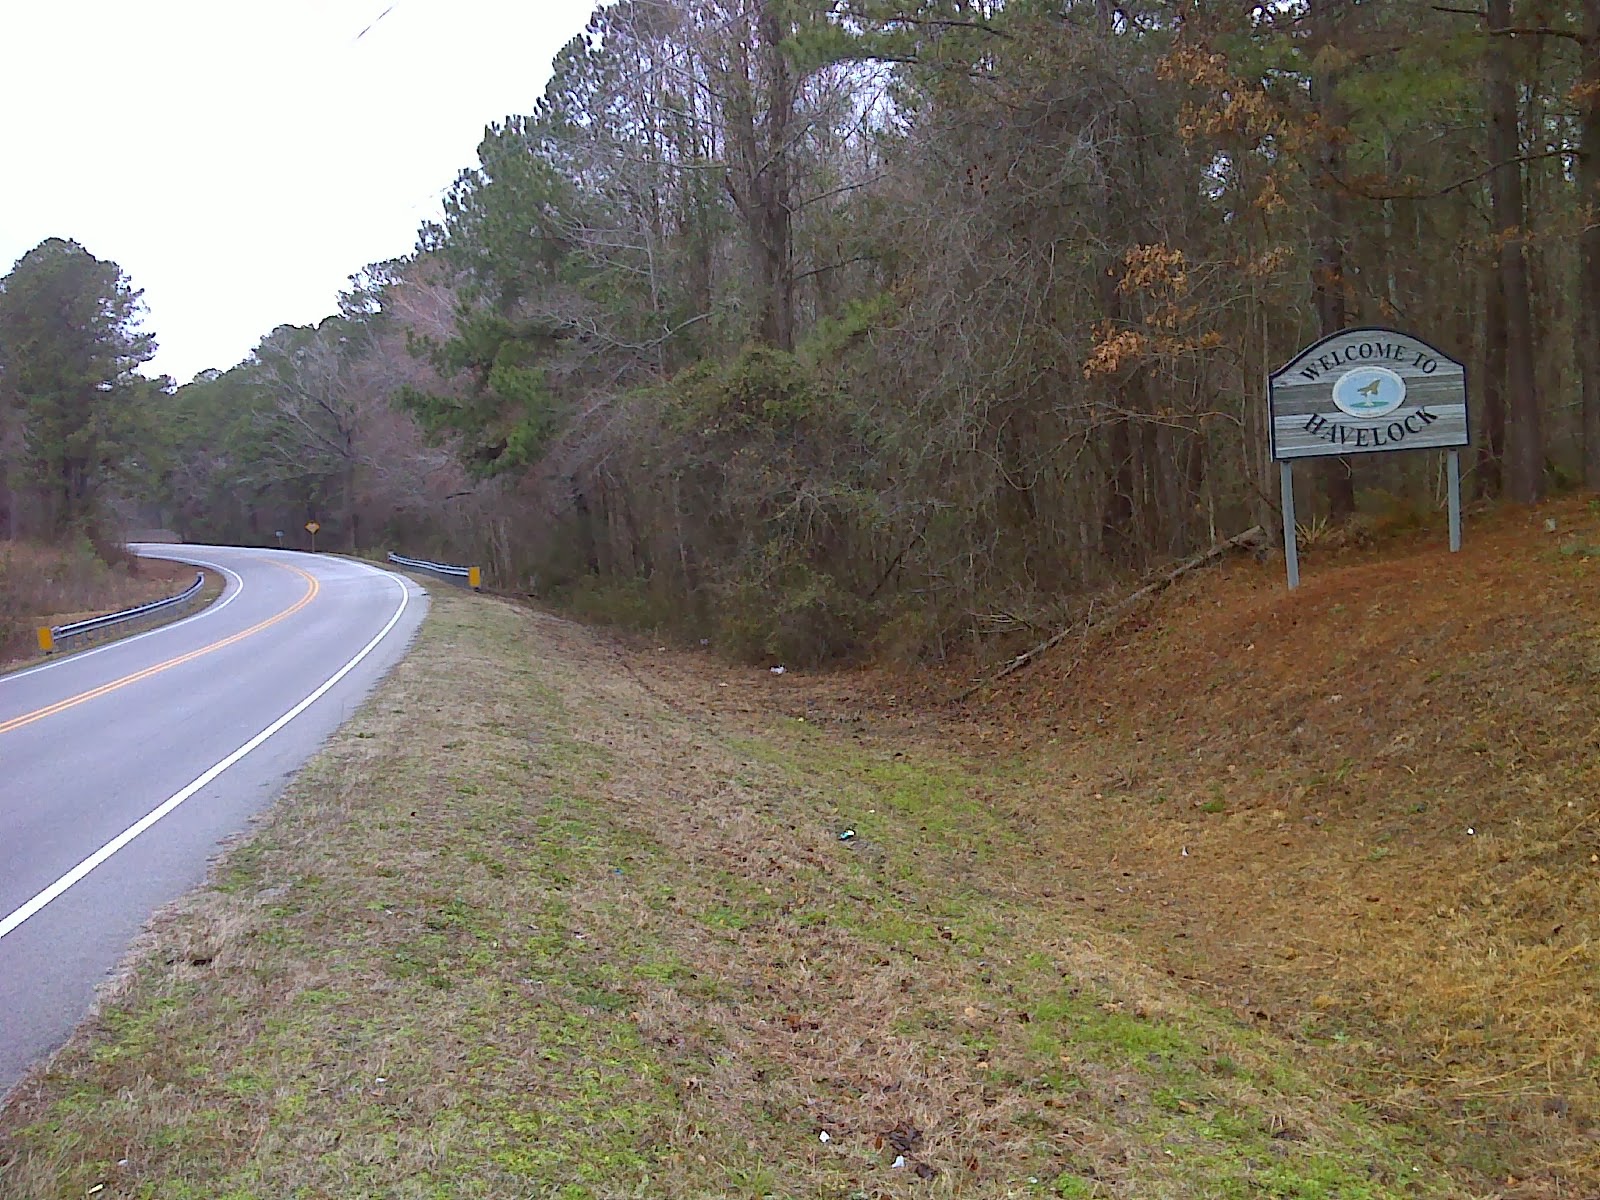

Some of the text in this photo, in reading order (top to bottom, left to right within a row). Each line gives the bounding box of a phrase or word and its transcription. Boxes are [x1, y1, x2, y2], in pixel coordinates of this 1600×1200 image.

[1300, 342, 1437, 381] WELCOME TO
[1302, 406, 1438, 447] HAVELOCK
